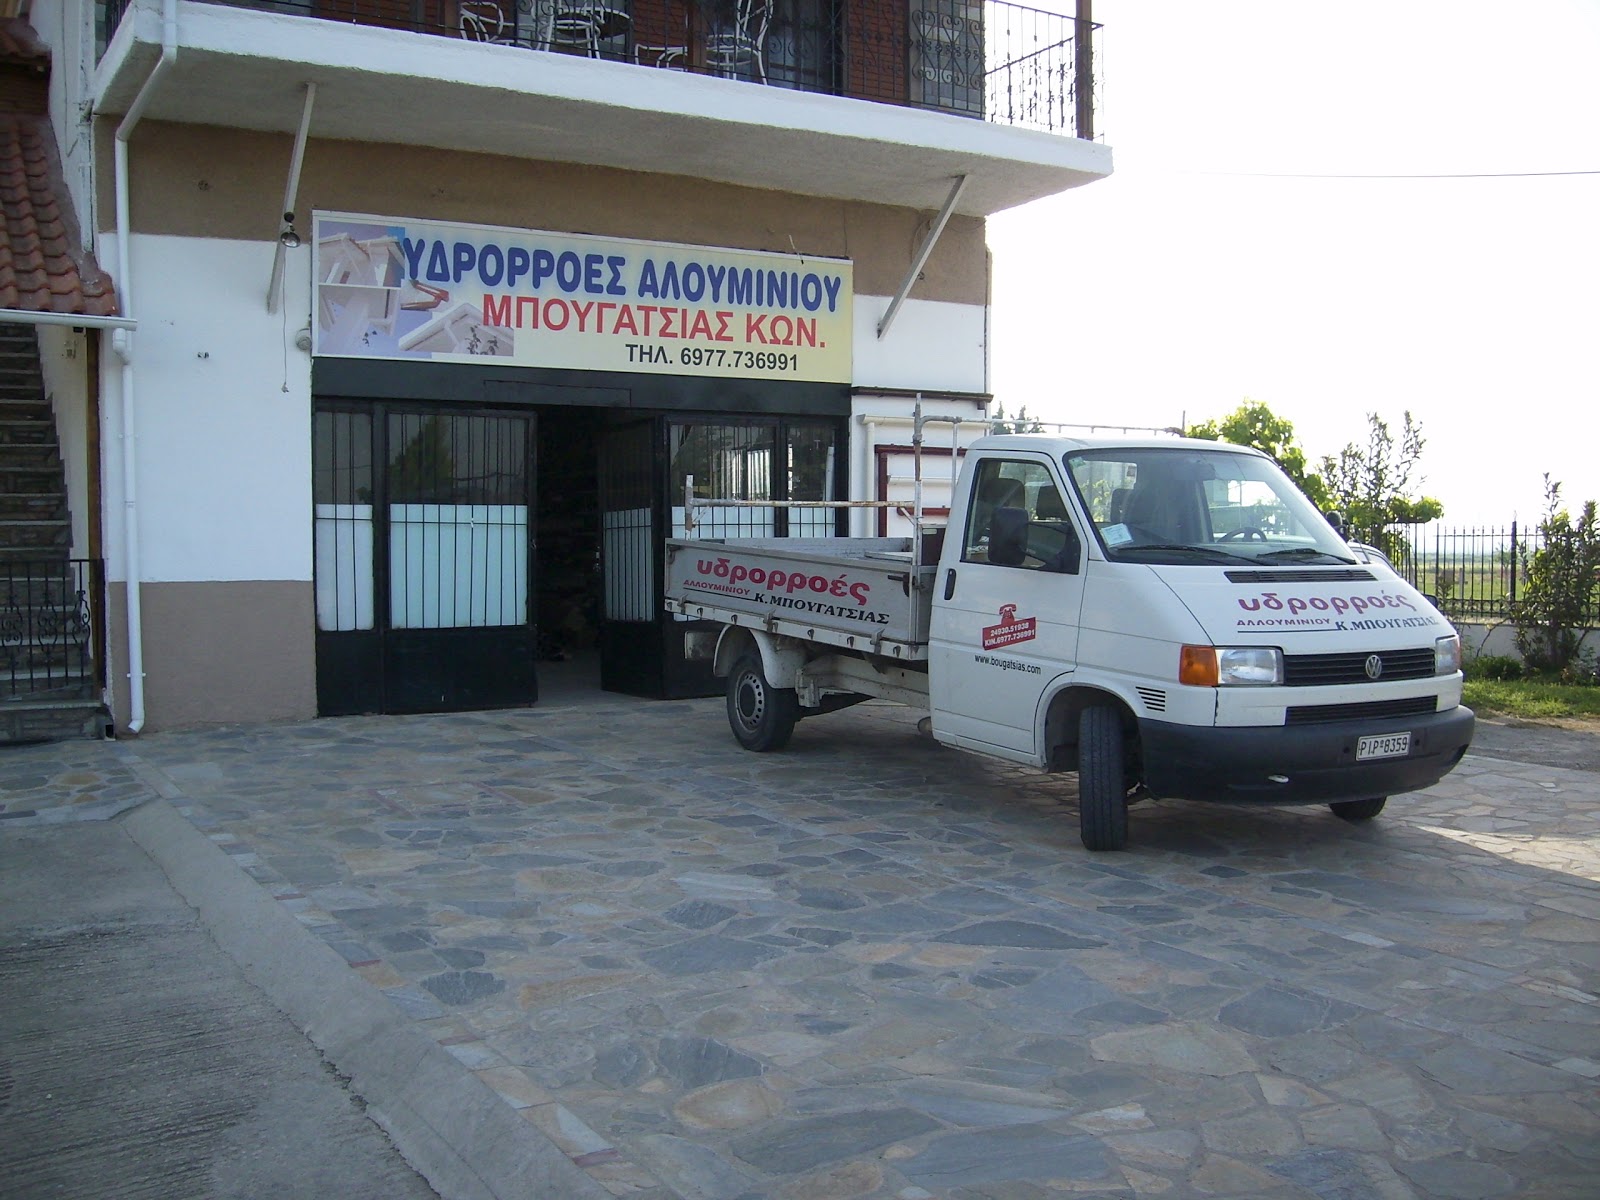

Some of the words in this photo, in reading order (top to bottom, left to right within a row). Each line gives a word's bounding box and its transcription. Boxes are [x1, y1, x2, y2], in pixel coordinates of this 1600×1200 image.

[403, 237, 626, 296] ΥΔΡΟΡΡΟΕΣ
[639, 259, 841, 312] ΑΛΟΥΜΙΝΙΟΥ
[482, 293, 734, 341] ΜΠΟΥΓΑΤΣΙΑΣ
[745, 313, 827, 348] ΚΩΝ.
[625, 344, 674, 365] ΤΗΛ.
[680, 349, 799, 372] 6977.736991
[697, 558, 871, 606] υδρορροές
[974, 655, 1042, 675] www.bougatsias.com
